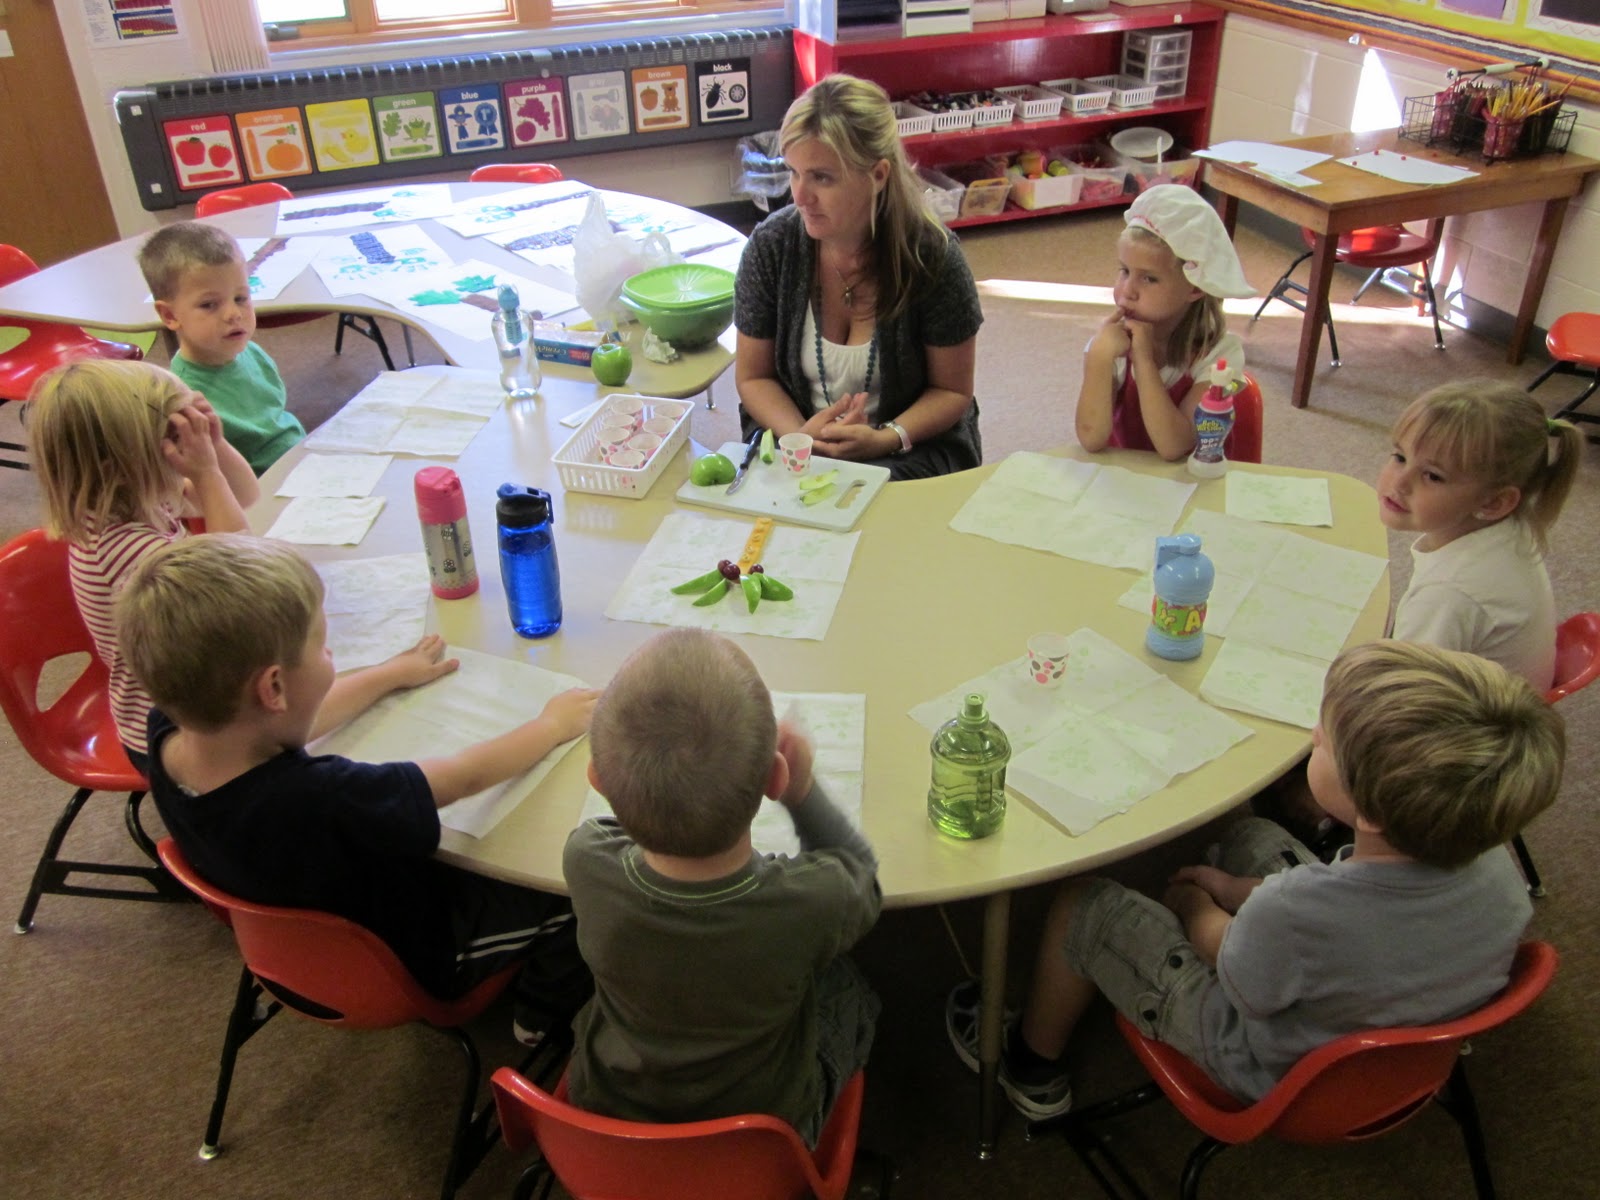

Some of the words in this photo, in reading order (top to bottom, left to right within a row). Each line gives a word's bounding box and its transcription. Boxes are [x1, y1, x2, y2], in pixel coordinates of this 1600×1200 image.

[713, 63, 732, 72] black
[647, 71, 672, 79] brown
[521, 84, 547, 95] purple
[461, 91, 479, 100] blue
[392, 99, 417, 109] green
[190, 122, 206, 131] red
